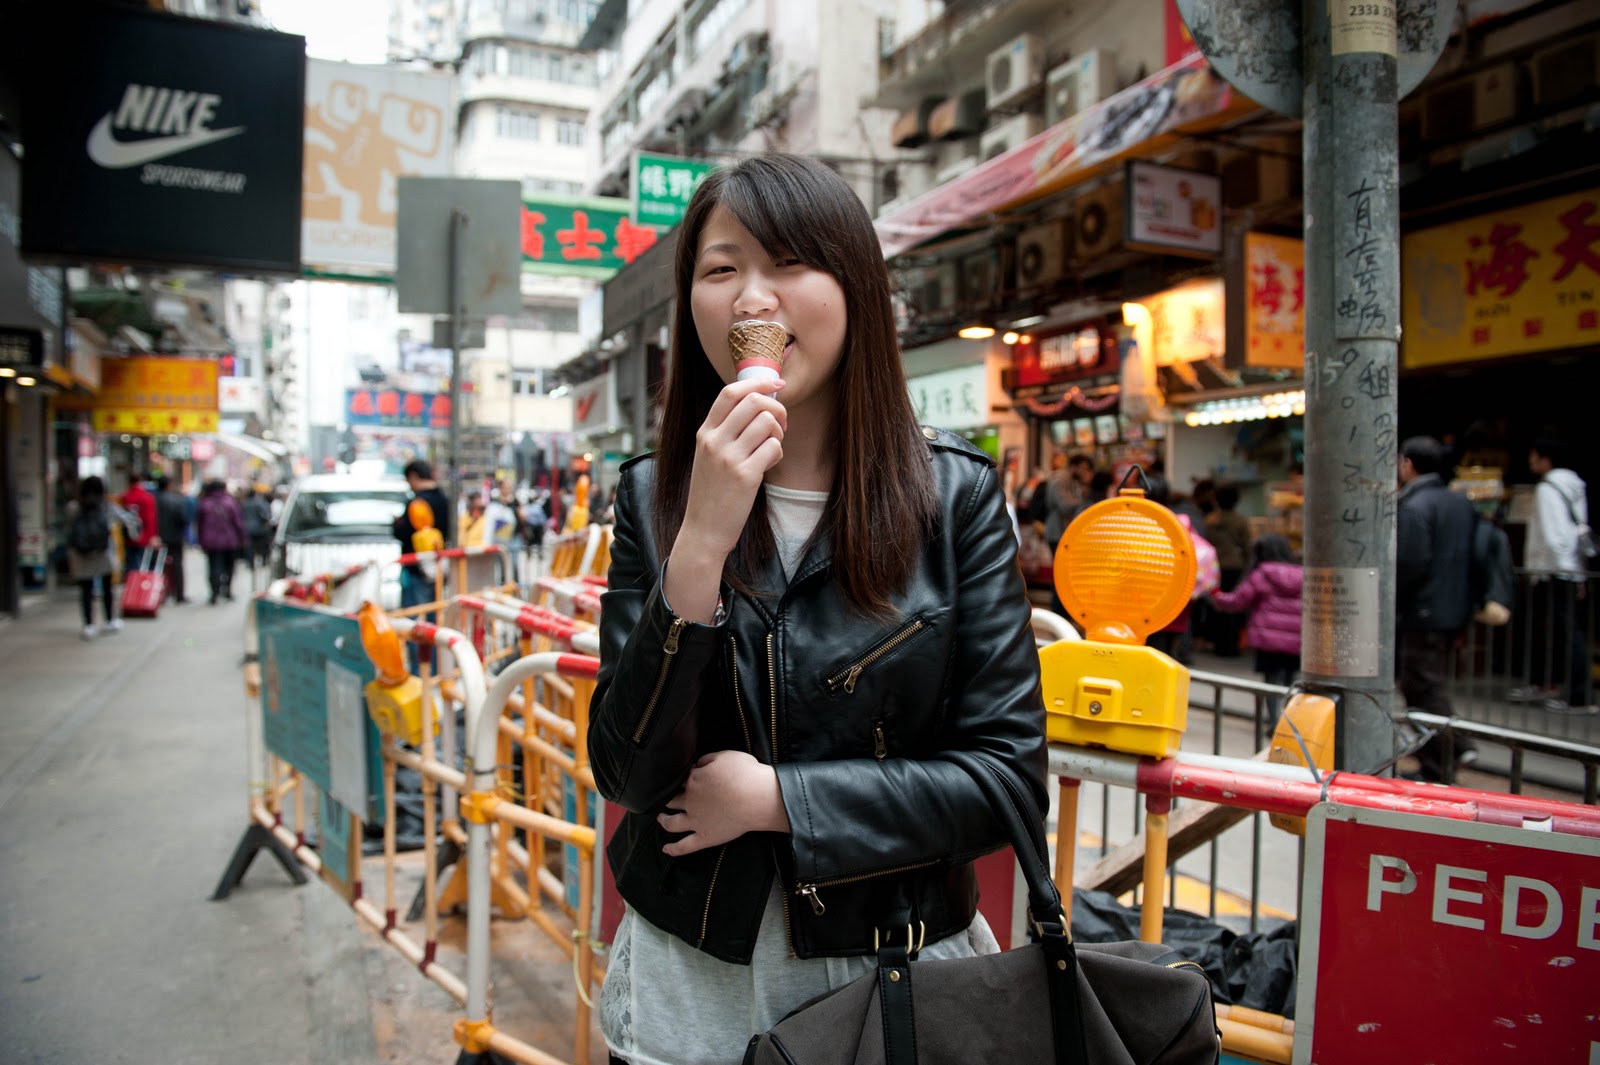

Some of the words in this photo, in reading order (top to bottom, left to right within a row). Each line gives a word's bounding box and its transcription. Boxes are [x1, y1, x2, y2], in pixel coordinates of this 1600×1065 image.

[114, 83, 222, 135] NIKE
[140, 163, 247, 194] SPORTSWEAR
[640, 164, 706, 202] 綠野
